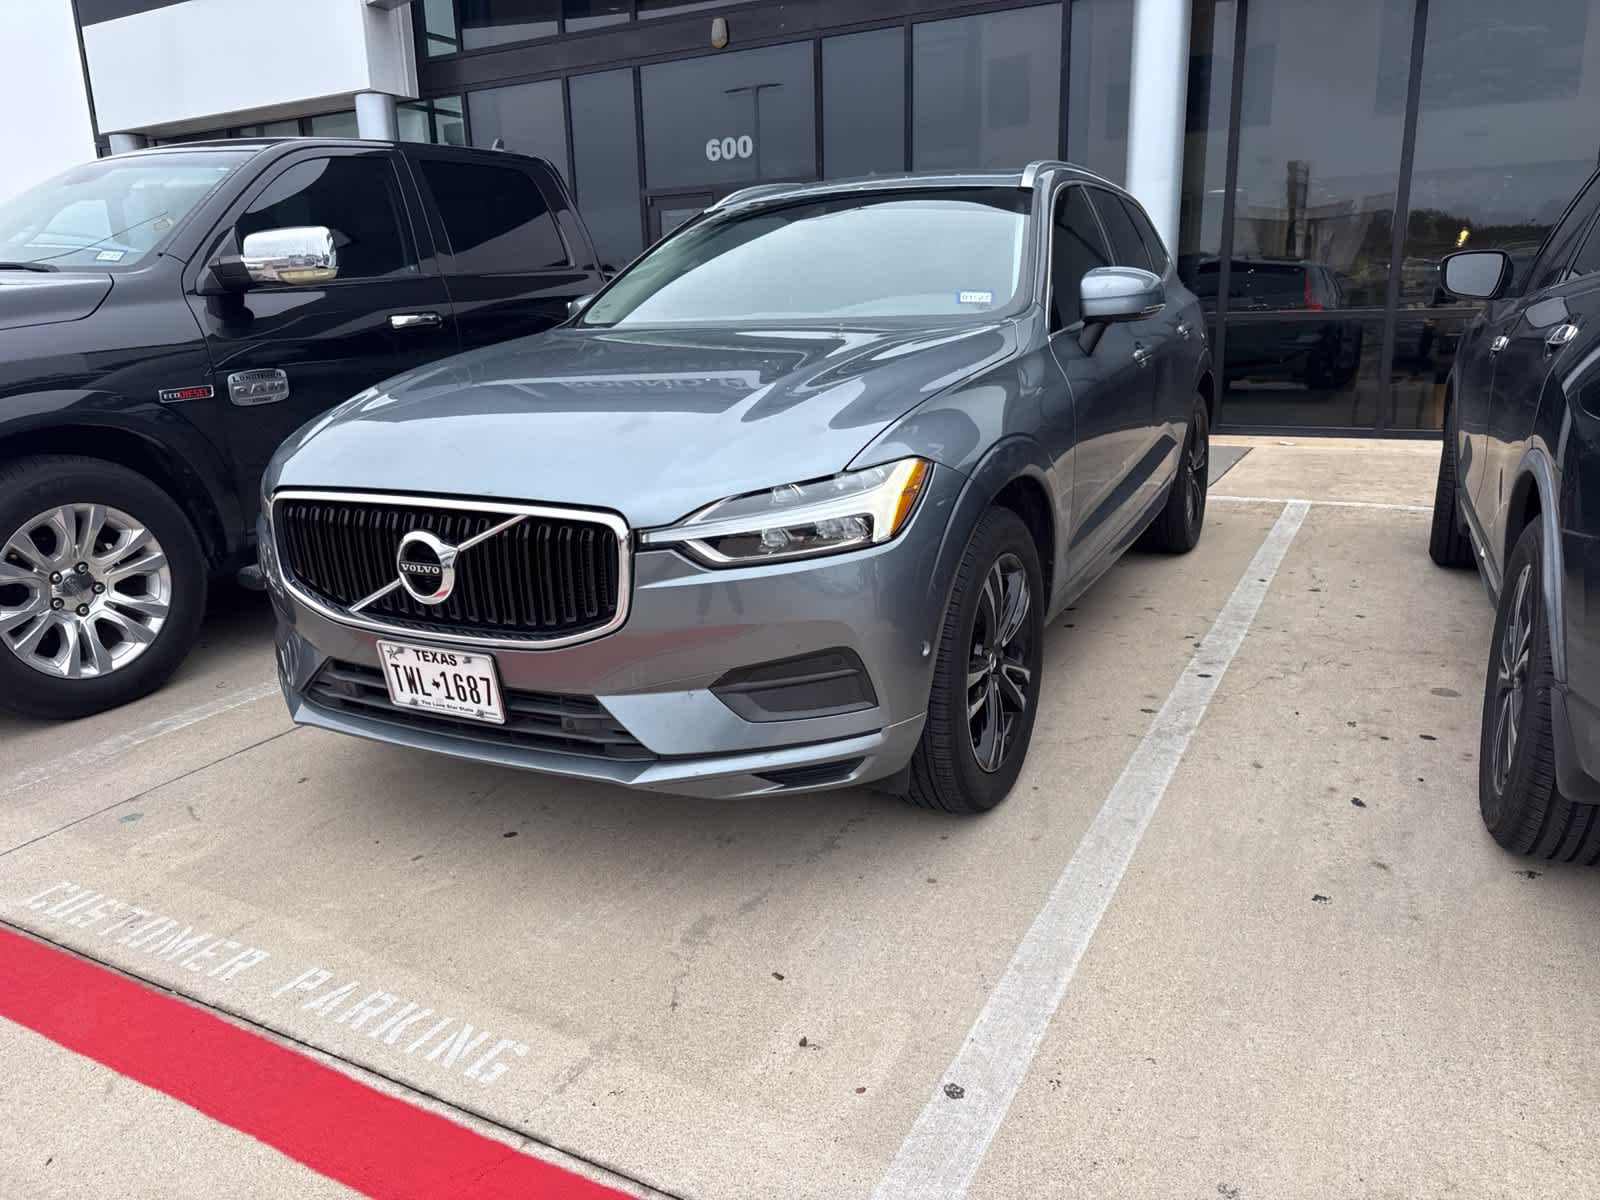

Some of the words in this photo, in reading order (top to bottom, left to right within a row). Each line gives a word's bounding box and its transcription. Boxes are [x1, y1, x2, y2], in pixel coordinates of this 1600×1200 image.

[706, 135, 753, 161] 600
[401, 563, 440, 574] VOLVO
[413, 649, 457, 667] TEXAS
[24, 881, 270, 983] CUSTOMER
[269, 966, 531, 1084] PARKING
